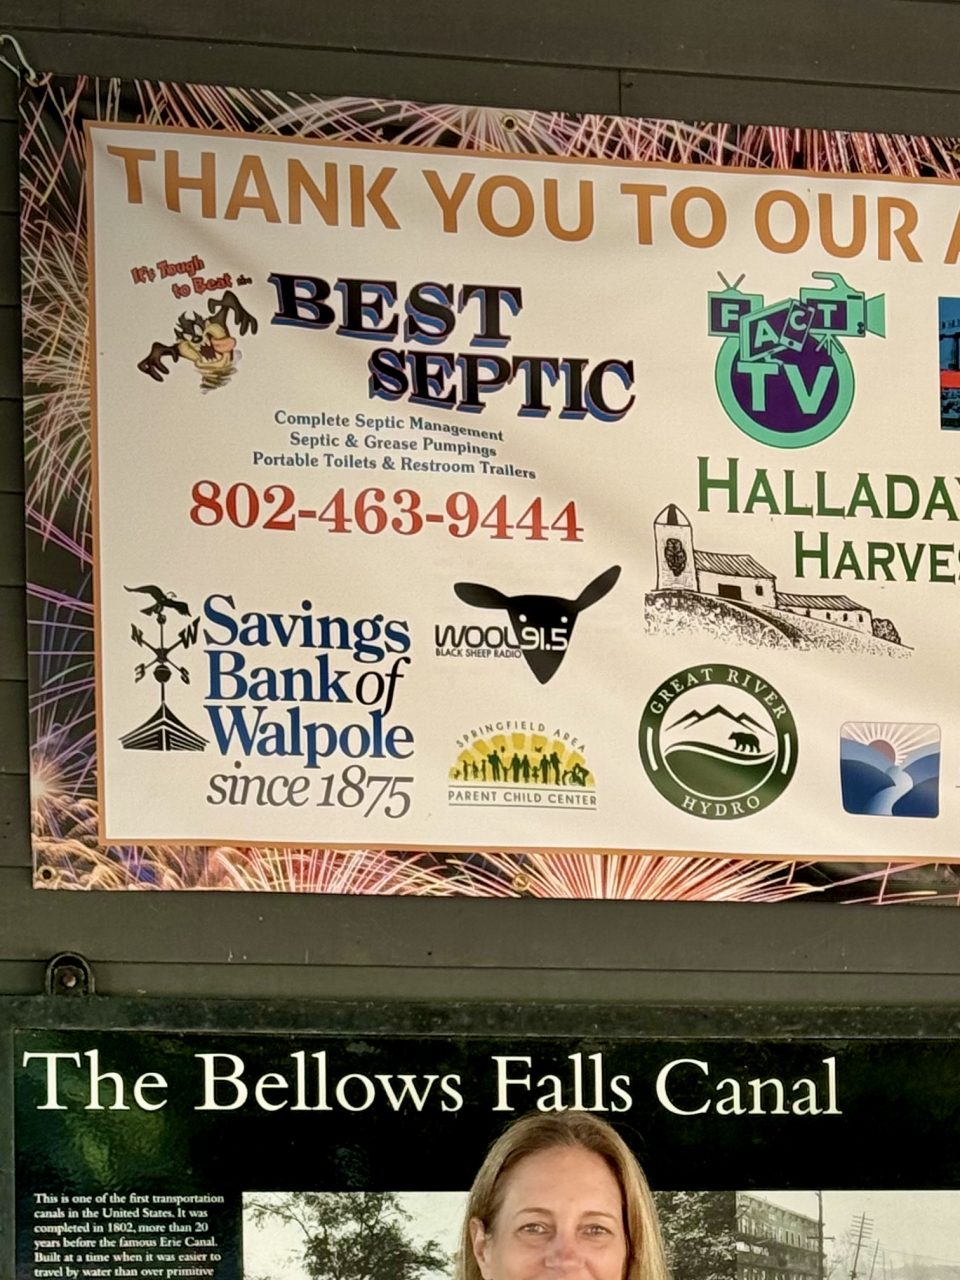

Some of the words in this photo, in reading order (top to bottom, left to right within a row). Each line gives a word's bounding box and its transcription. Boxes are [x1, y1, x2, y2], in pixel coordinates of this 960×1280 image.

[107, 145, 402, 229] THANK
[422, 170, 593, 242] YOU
[620, 183, 727, 249] TO
[754, 188, 923, 262] OUR
[131, 266, 156, 284] It's
[157, 255, 205, 279] Tough
[172, 283, 191, 299] to
[192, 273, 232, 294] Beat
[268, 272, 523, 348] BEST
[721, 303, 837, 348] FACT
[368, 348, 636, 422] SEPTIC
[737, 361, 834, 414] TV
[274, 410, 350, 430] Complete
[355, 414, 404, 430] Septic
[410, 416, 504, 442] Management
[290, 432, 340, 449] Septic
[345, 434, 358, 448] &
[364, 435, 418, 450] Grease
[423, 438, 497, 458] Pumpings
[253, 452, 319, 468] Portable
[324, 454, 376, 470] Toilets
[382, 456, 396, 470] &
[400, 458, 475, 474] Restroom
[480, 461, 536, 480] Trailers
[190, 480, 585, 543] 802-463-9444
[203, 594, 411, 663] Savings
[435, 625, 521, 649] WOOL
[521, 627, 568, 650] 91.5
[435, 648, 462, 657] BLACK
[466, 649, 491, 657] SHEEP
[494, 649, 521, 658] RADIO
[204, 650, 353, 703] Bank
[355, 656, 411, 718] of
[651, 668, 713, 714] GREAT
[727, 669, 786, 719] RIVER
[203, 705, 414, 769] Walpole
[456, 721, 545, 748] SPRINGFIELD
[553, 729, 585, 753] AREA
[207, 760, 310, 807] since
[316, 764, 414, 819] 1875
[448, 790, 497, 801] PARENT
[504, 792, 542, 803] CHILD
[548, 794, 597, 805] CENTER
[681, 796, 759, 816] HYDRO
[22, 1050, 168, 1112] The
[195, 1052, 463, 1113] Bellows
[491, 1054, 632, 1114] Falls
[655, 1056, 843, 1117] Canal
[33, 1193, 58, 1204] This
[61, 1194, 69, 1203] is
[95, 1193, 108, 1203] of
[109, 1193, 126, 1203] the
[129, 1193, 149, 1203] first
[152, 1194, 225, 1205] transportation
[34, 1208, 65, 1218] canals
[68, 1209, 79, 1218] in
[82, 1208, 99, 1218] the
[102, 1208, 139, 1218] United
[142, 1208, 175, 1218] States.
[178, 1208, 186, 1218] It
[189, 1210, 208, 1218] was
